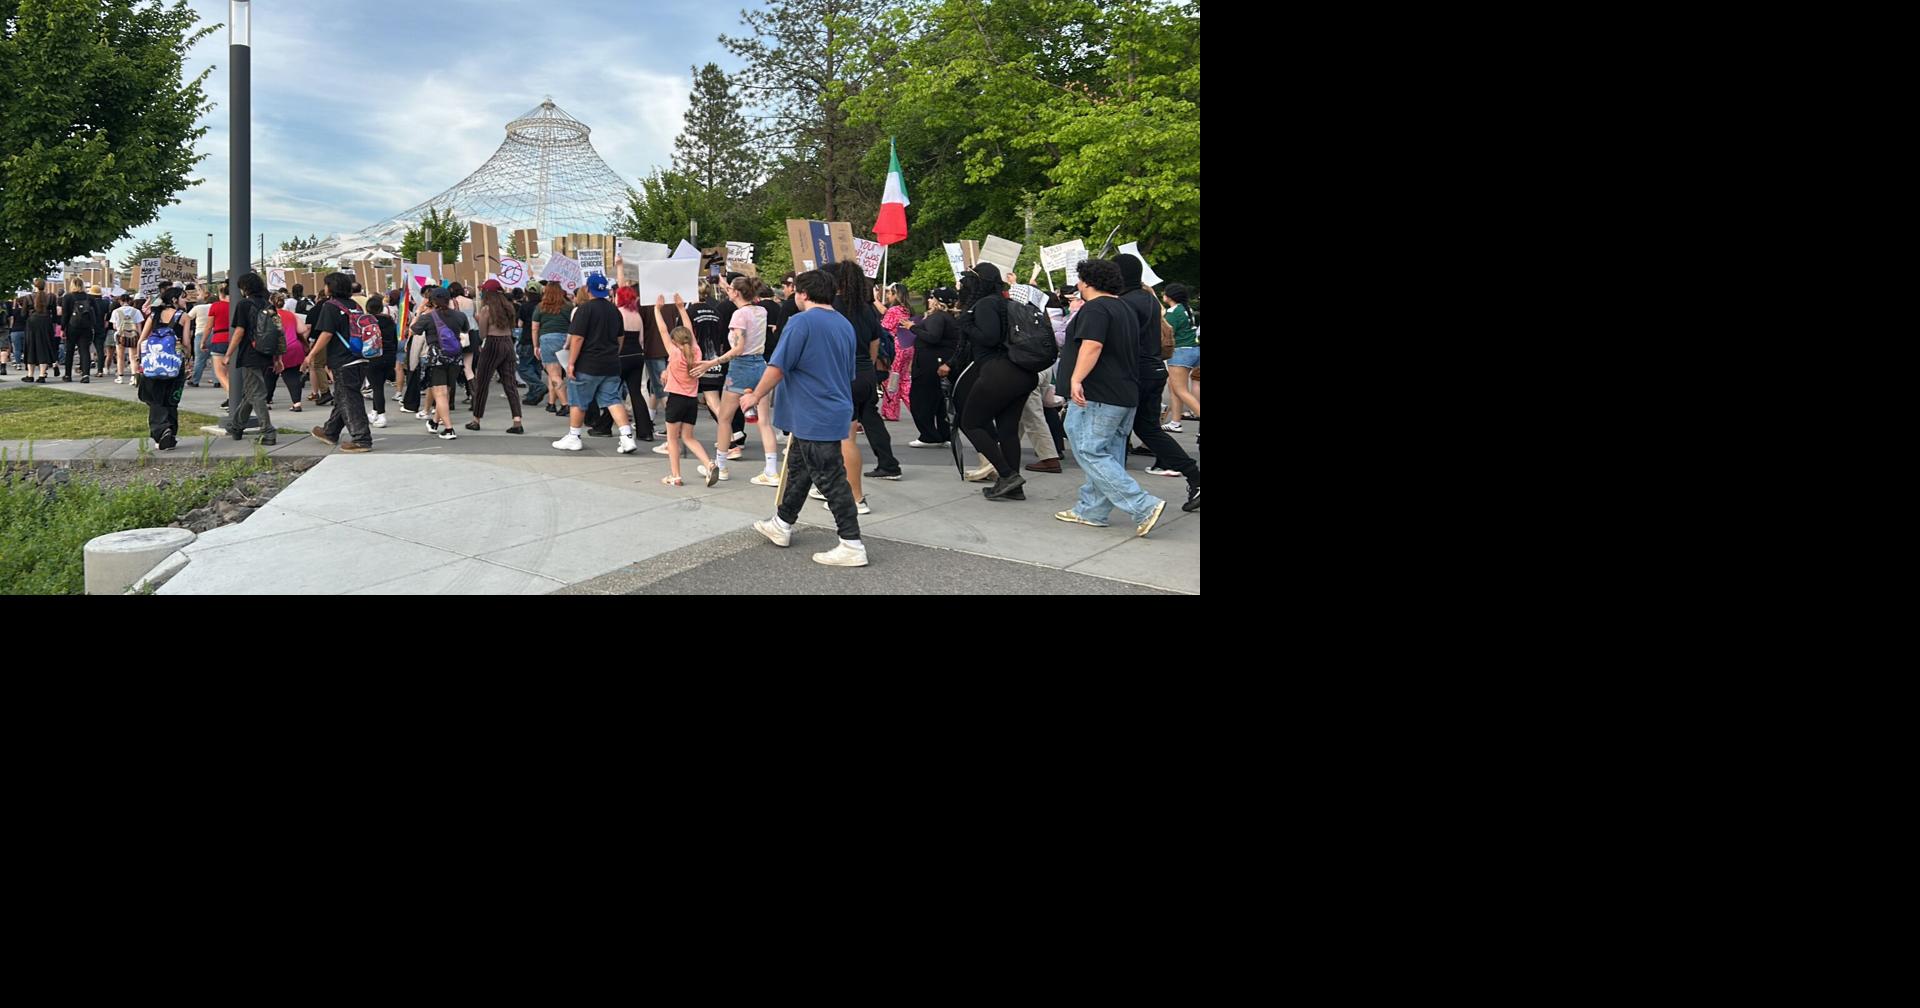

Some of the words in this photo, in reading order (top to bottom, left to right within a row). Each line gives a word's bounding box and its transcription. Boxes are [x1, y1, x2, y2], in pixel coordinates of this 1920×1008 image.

[143, 259, 159, 267] TAKE
[164, 255, 195, 268] SILENCE
[580, 260, 603, 268] GENOCIDE
[141, 274, 160, 286] ICE
